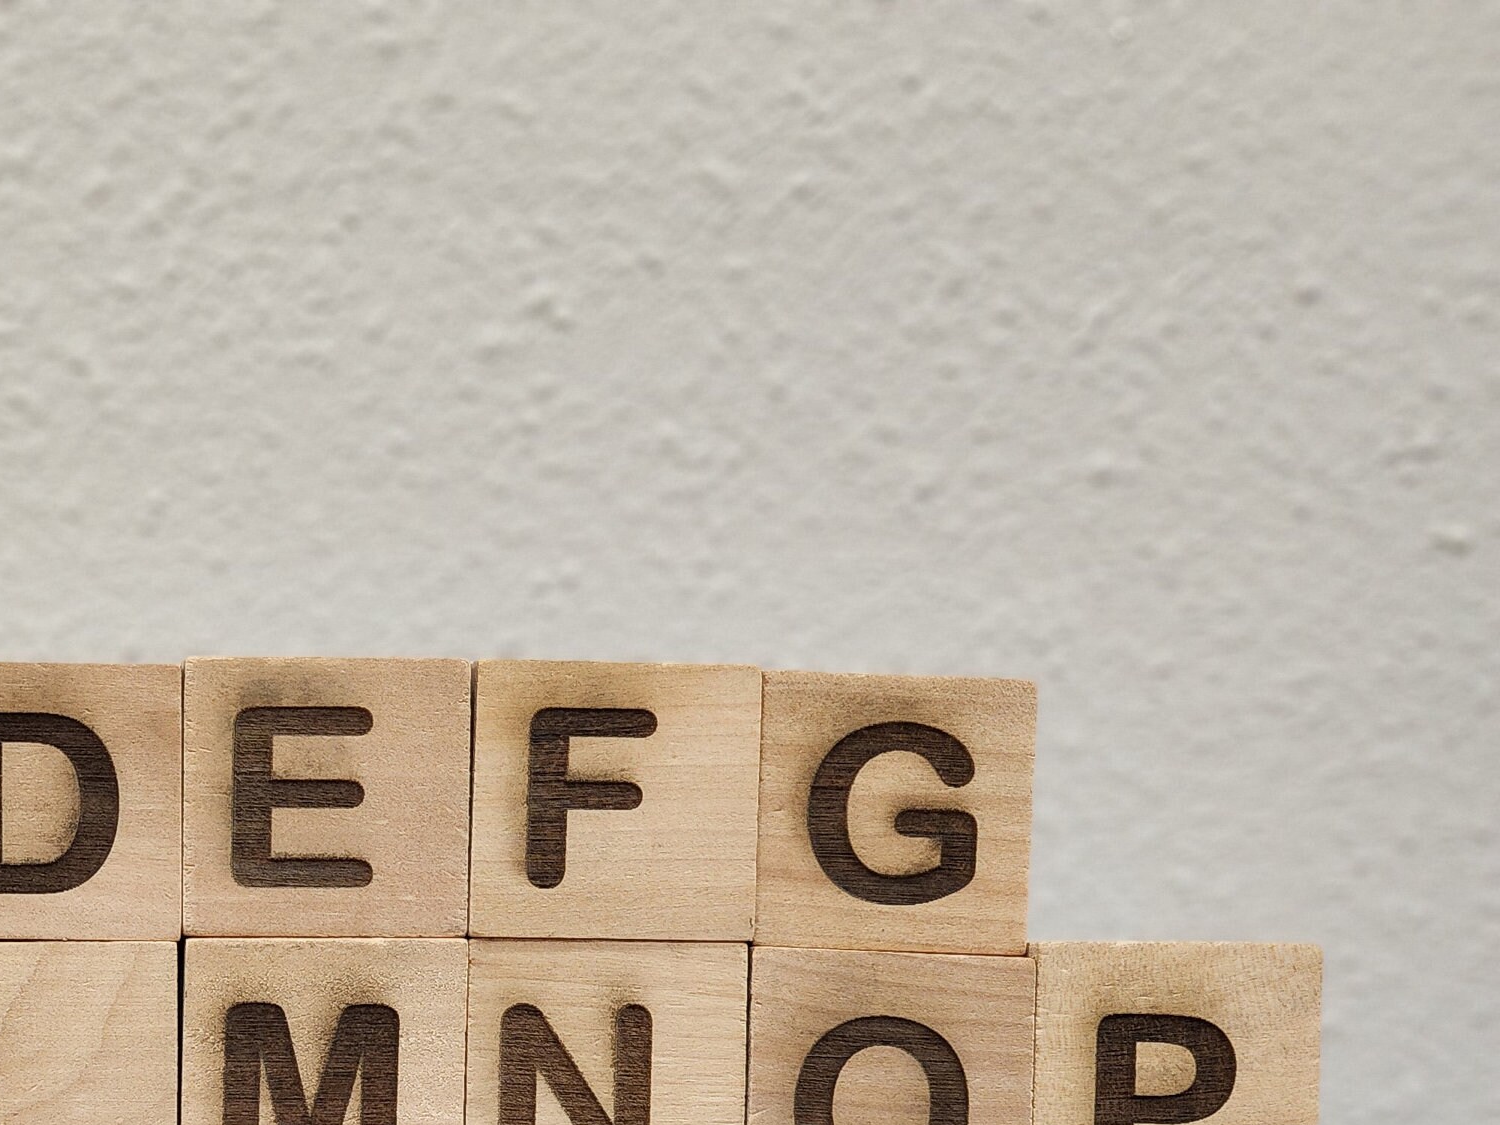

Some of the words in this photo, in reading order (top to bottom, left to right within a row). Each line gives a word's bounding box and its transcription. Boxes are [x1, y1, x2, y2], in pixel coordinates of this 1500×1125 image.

[231, 705, 373, 887] E
[525, 706, 657, 889] F
[804, 720, 977, 905] G
